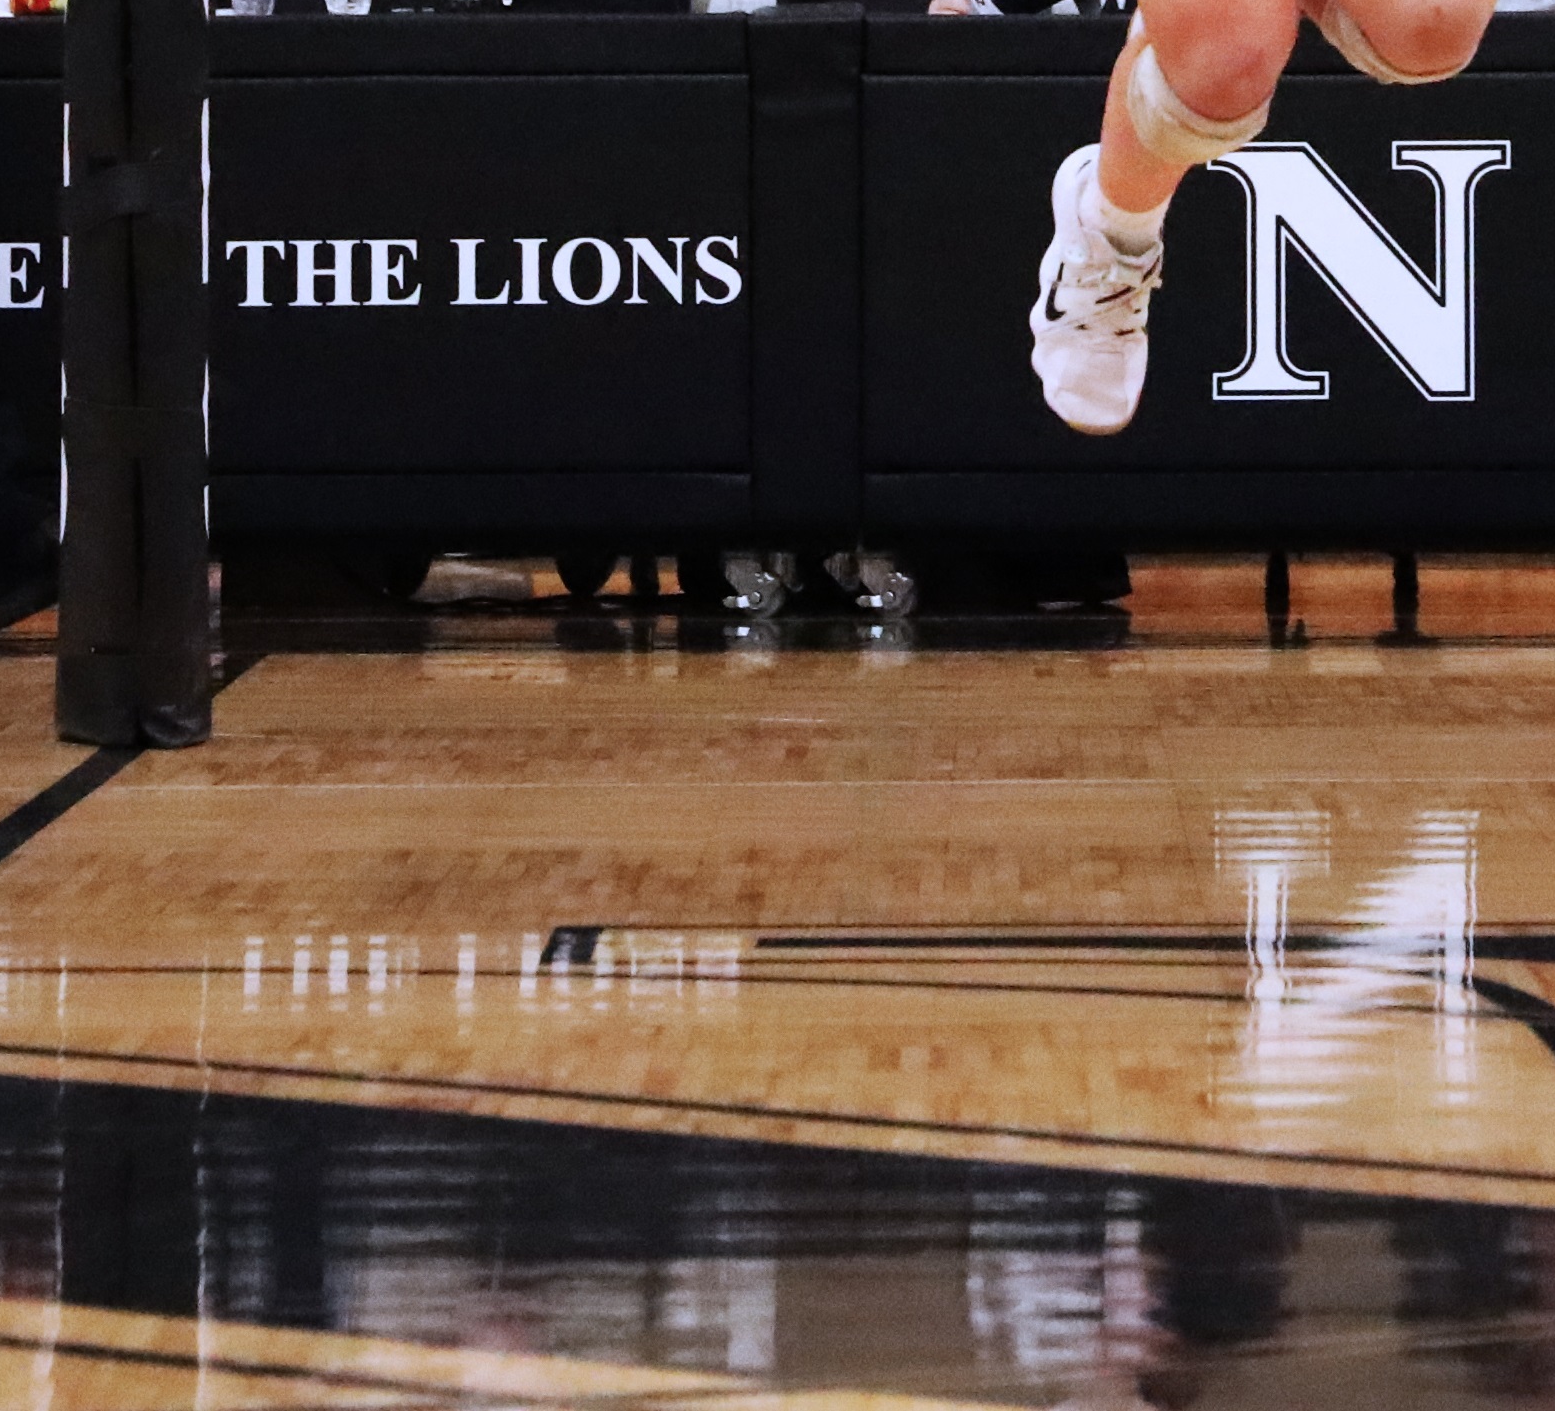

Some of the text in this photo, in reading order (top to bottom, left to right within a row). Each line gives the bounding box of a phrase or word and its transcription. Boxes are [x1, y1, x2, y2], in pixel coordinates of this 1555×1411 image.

[225, 238, 423, 308] THE
[449, 234, 743, 307] LIONS
[1206, 139, 1512, 401] N
